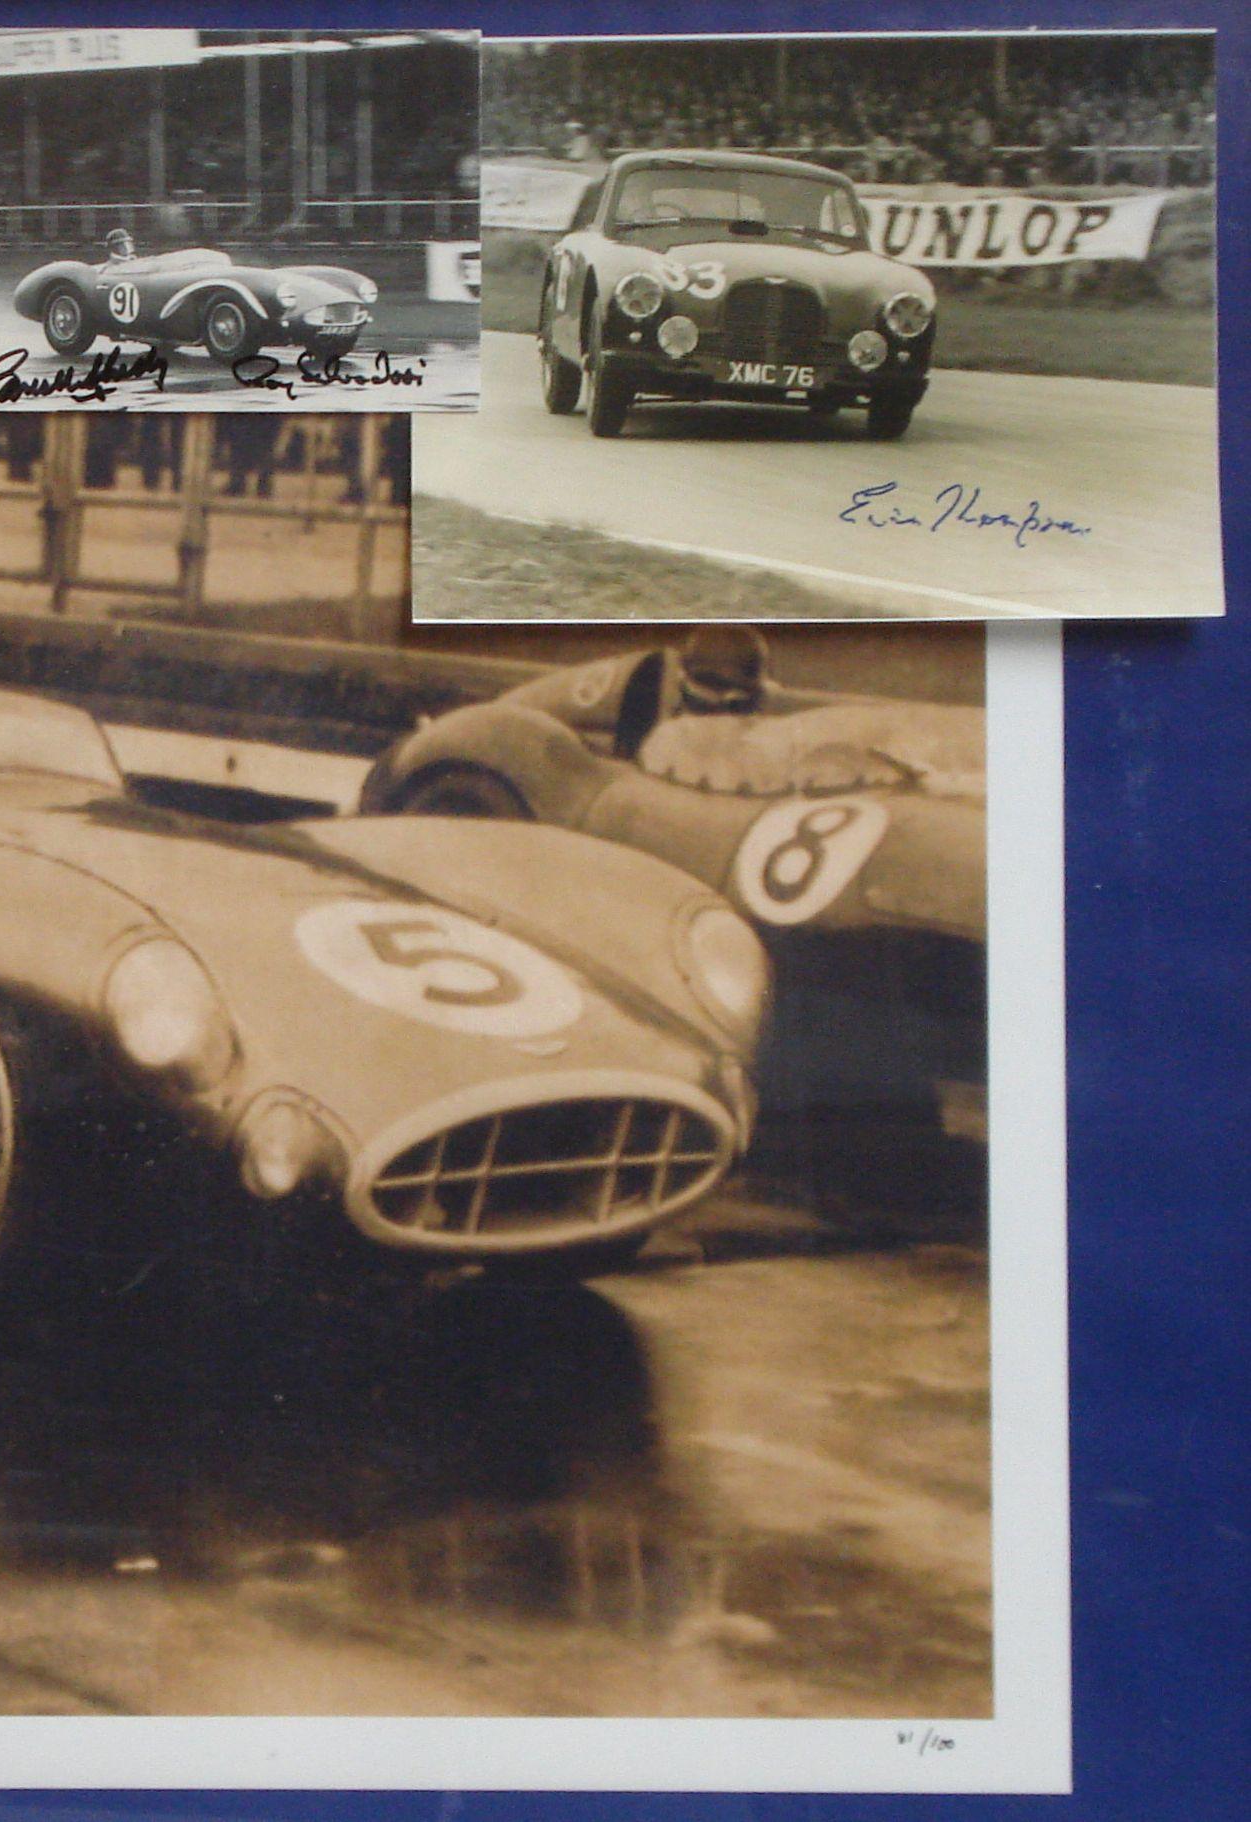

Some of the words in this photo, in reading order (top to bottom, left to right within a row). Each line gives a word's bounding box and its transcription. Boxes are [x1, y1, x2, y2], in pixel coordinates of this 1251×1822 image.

[881, 203, 1112, 260] UNLOP
[113, 286, 135, 318] 91
[728, 360, 777, 385] XMC
[781, 364, 815, 388] 76
[761, 805, 860, 904] 8
[357, 919, 525, 1007] 5
